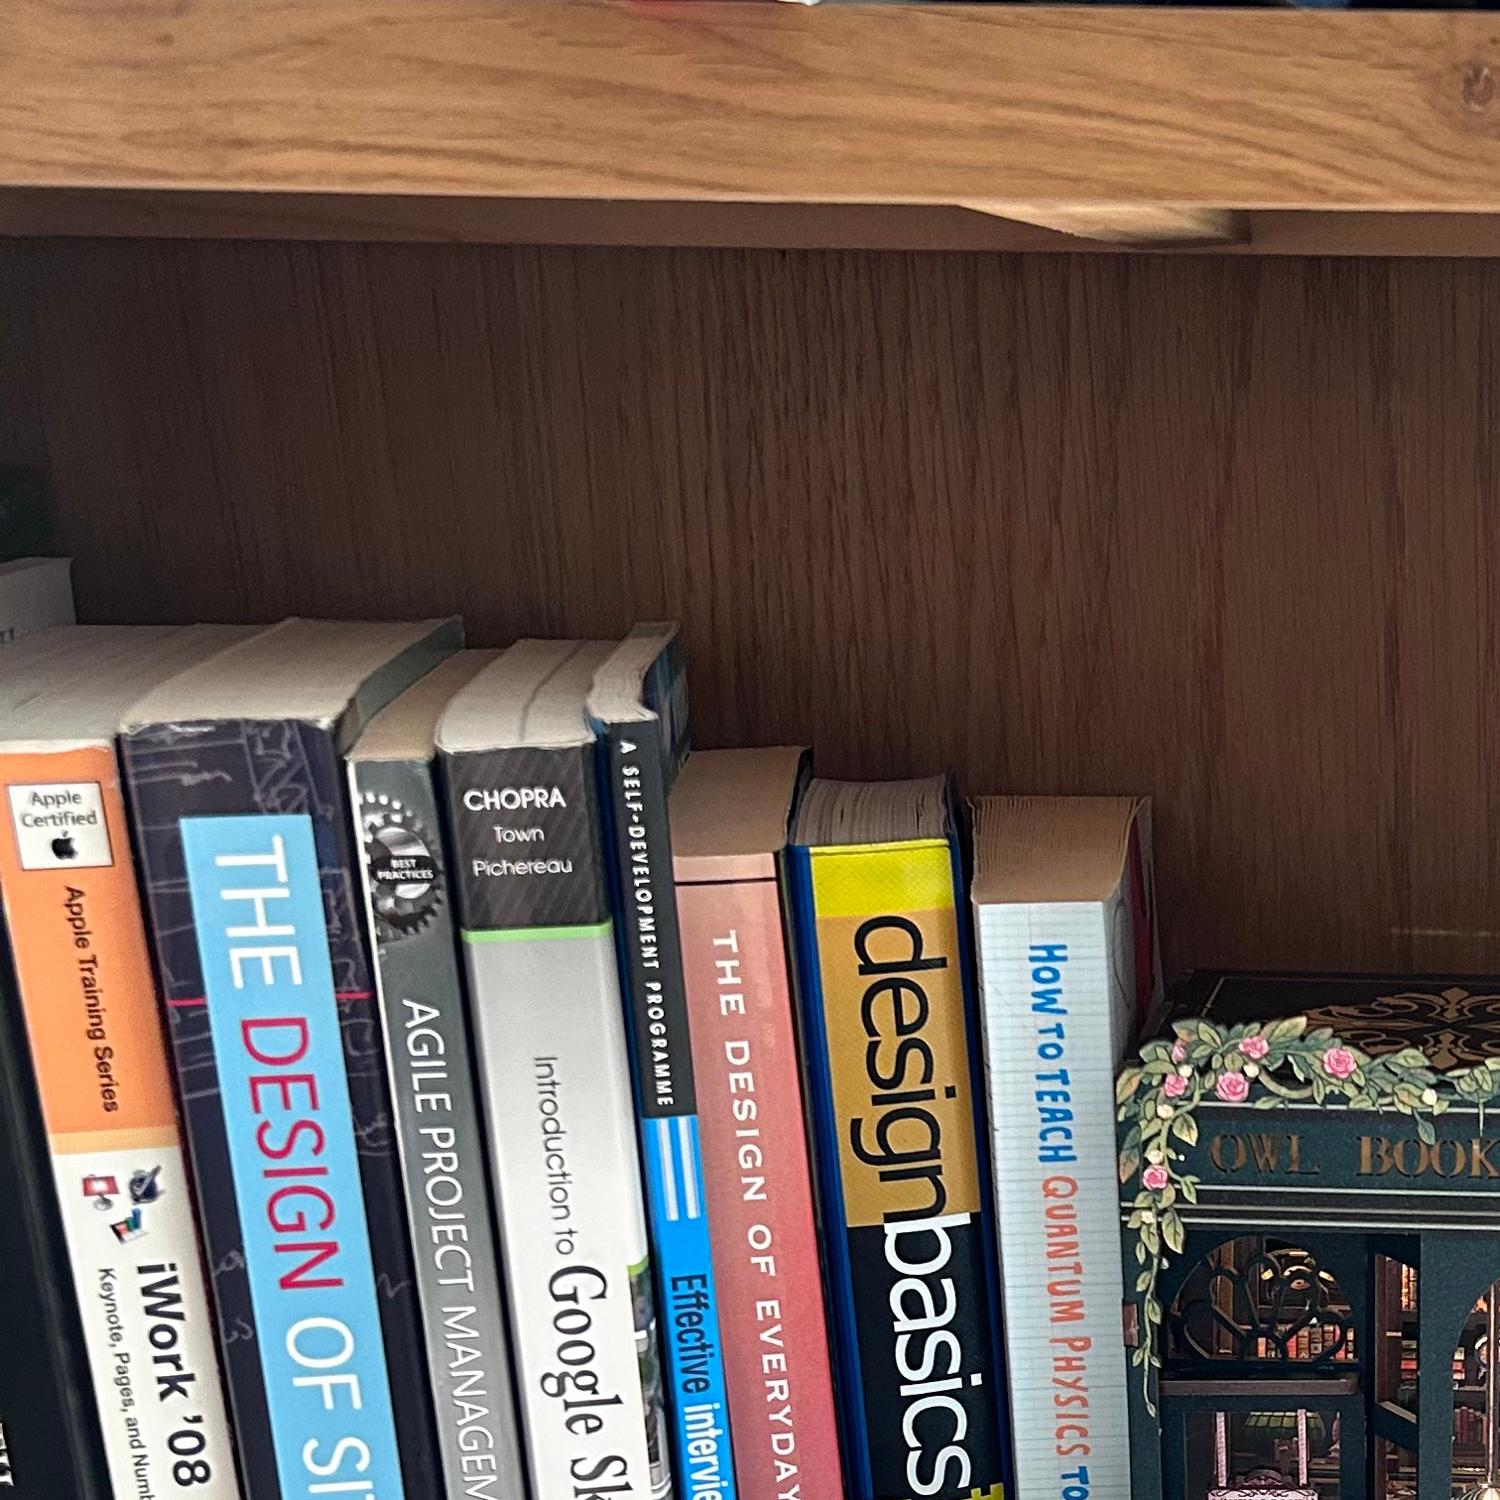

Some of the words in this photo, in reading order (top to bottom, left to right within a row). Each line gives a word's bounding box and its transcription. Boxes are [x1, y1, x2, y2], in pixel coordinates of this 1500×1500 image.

[620, 739, 637, 754] A
[22, 810, 98, 828] Certified
[30, 789, 82, 807] Apple
[463, 785, 566, 812] CHOPRA
[493, 826, 545, 844] Town
[376, 869, 434, 881] PRACTICES
[390, 859, 417, 869] BEST
[472, 855, 573, 878] Pichereau
[621, 764, 660, 970] SELF-DEVELOPMENT
[63, 885, 90, 948] Apple
[214, 834, 303, 990] THE
[75, 952, 103, 1041] Training
[712, 929, 747, 1016] THE
[1028, 943, 1069, 1016] HOW
[93, 1046, 119, 1113] Series
[402, 999, 454, 1114] AGILE
[645, 981, 675, 1106] PROGRAMME
[240, 1016, 345, 1291] DESIGN
[534, 1055, 574, 1219] Introduction
[725, 1039, 768, 1201] DESIGN
[1035, 1069, 1078, 1164] TEACH
[1209, 1132, 1322, 1178] OWL
[417, 1126, 476, 1294] PROJECT
[554, 1226, 578, 1256] to
[747, 1224, 778, 1277] OF
[1042, 1175, 1086, 1325] QUANTUM
[98, 1267, 120, 1349] Keynote,
[113, 1351, 137, 1413] Pages,
[125, 1417, 144, 1451] and
[136, 1261, 198, 1403] iWork
[286, 1316, 363, 1411] OF
[541, 1264, 625, 1436] Google
[670, 1272, 709, 1395] Effective
[1048, 1336, 1091, 1458] PHYSICS
[1060, 1466, 1091, 1500] TO
